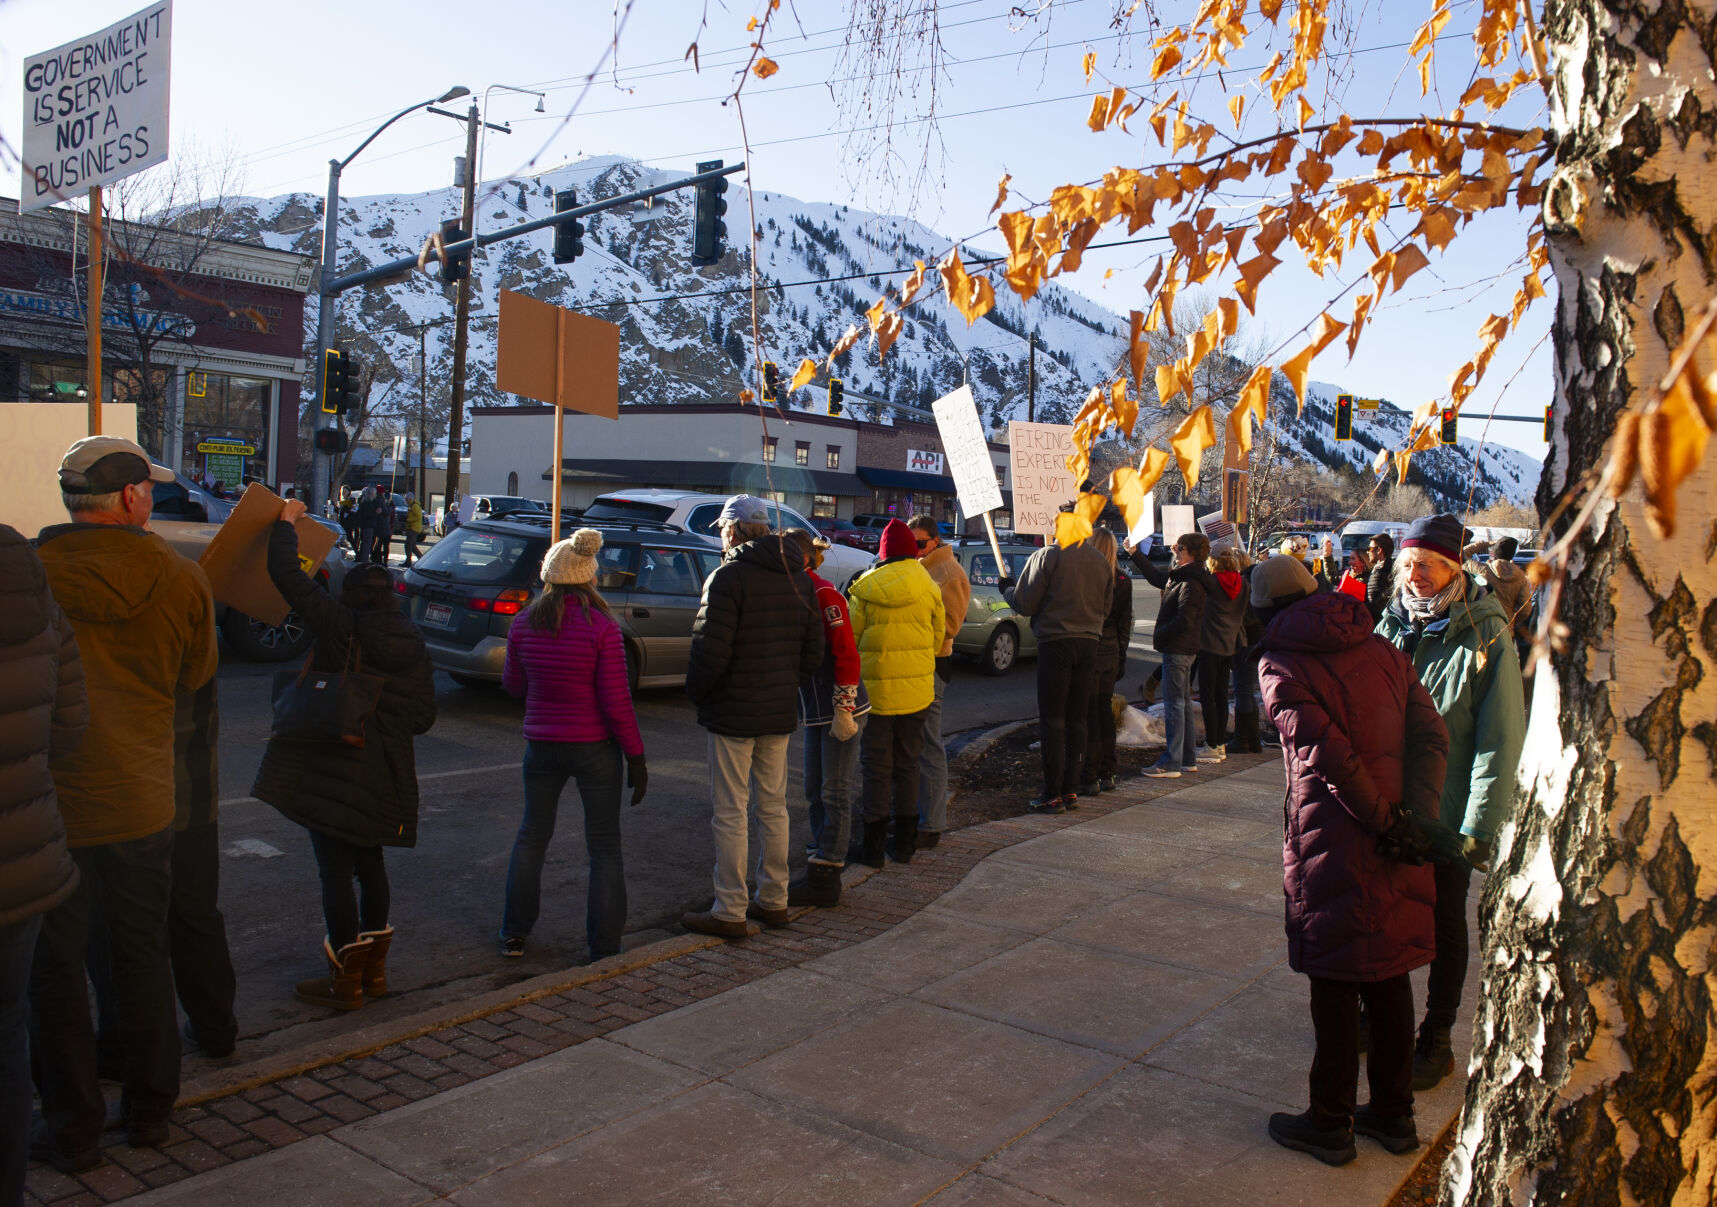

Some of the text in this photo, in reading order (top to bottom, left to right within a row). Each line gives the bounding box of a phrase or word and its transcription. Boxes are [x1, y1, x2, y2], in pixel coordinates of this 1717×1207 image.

[25, 8, 166, 92] GOVERNMENT
[34, 52, 148, 123] IS SERVICE
[56, 104, 119, 152] NOT A
[35, 126, 149, 196] BUSINESS
[1015, 428, 1071, 450] FIRING
[1016, 451, 1076, 469] EXPERT
[1016, 475, 1068, 494] IS NOT
[1016, 493, 1042, 505] THE
[1019, 511, 1056, 527] ANSW
